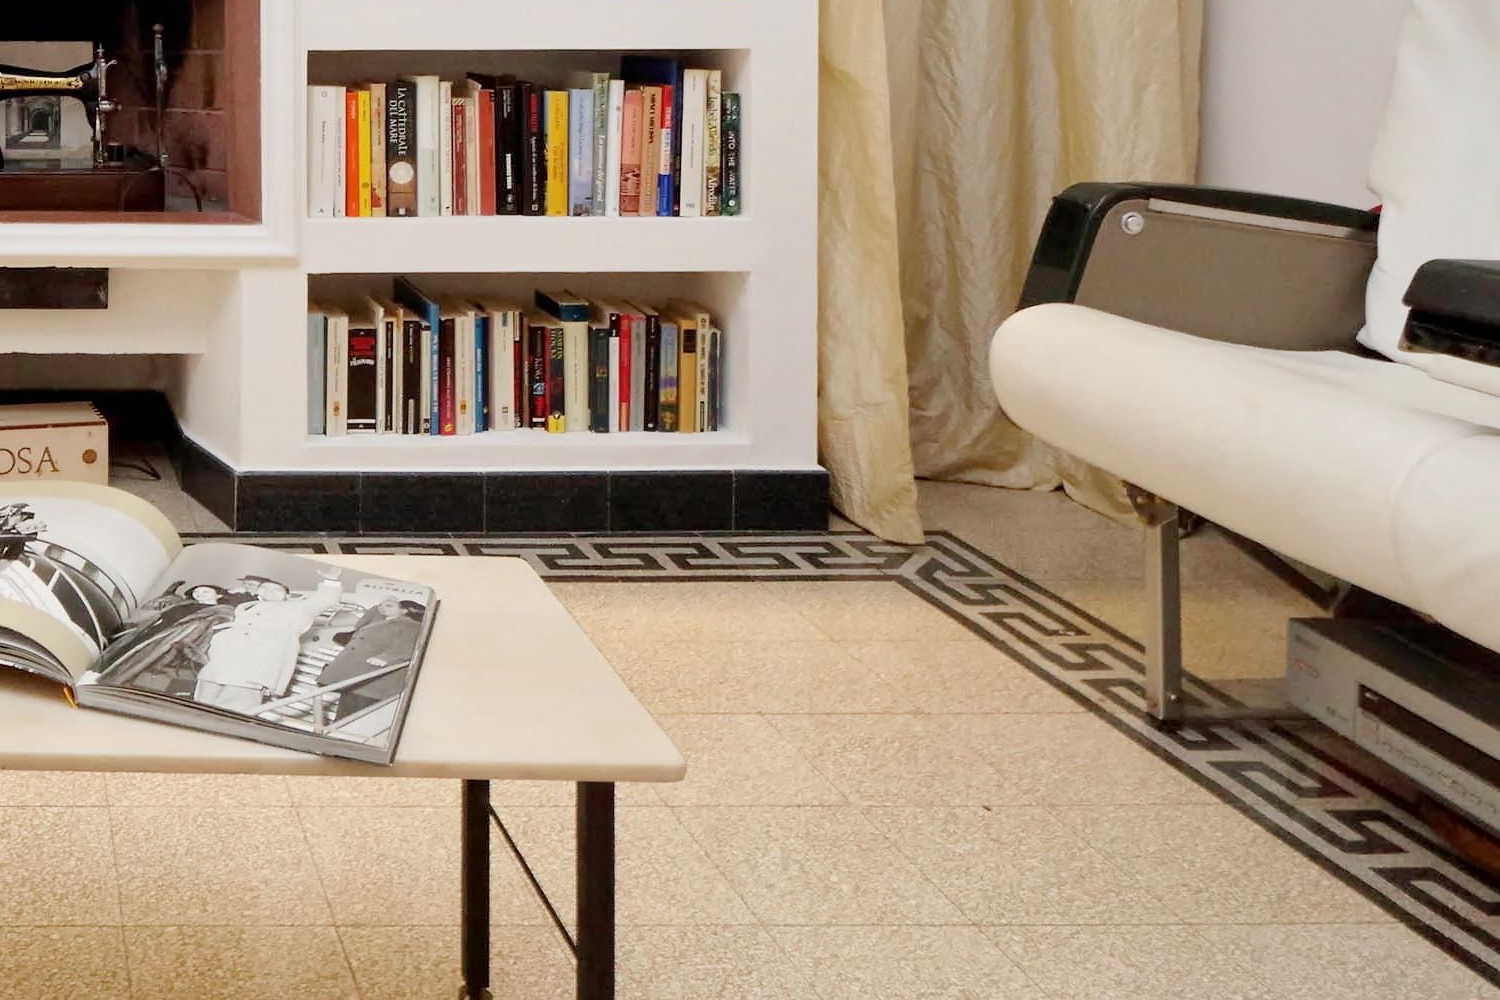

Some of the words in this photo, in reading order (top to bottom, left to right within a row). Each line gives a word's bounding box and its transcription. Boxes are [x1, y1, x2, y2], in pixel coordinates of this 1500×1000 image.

[398, 88, 408, 98] LA
[389, 100, 398, 116] DEL
[389, 118, 398, 145] MARE
[397, 99, 409, 156] CATTEDRALE
[707, 175, 717, 211] Afrodita
